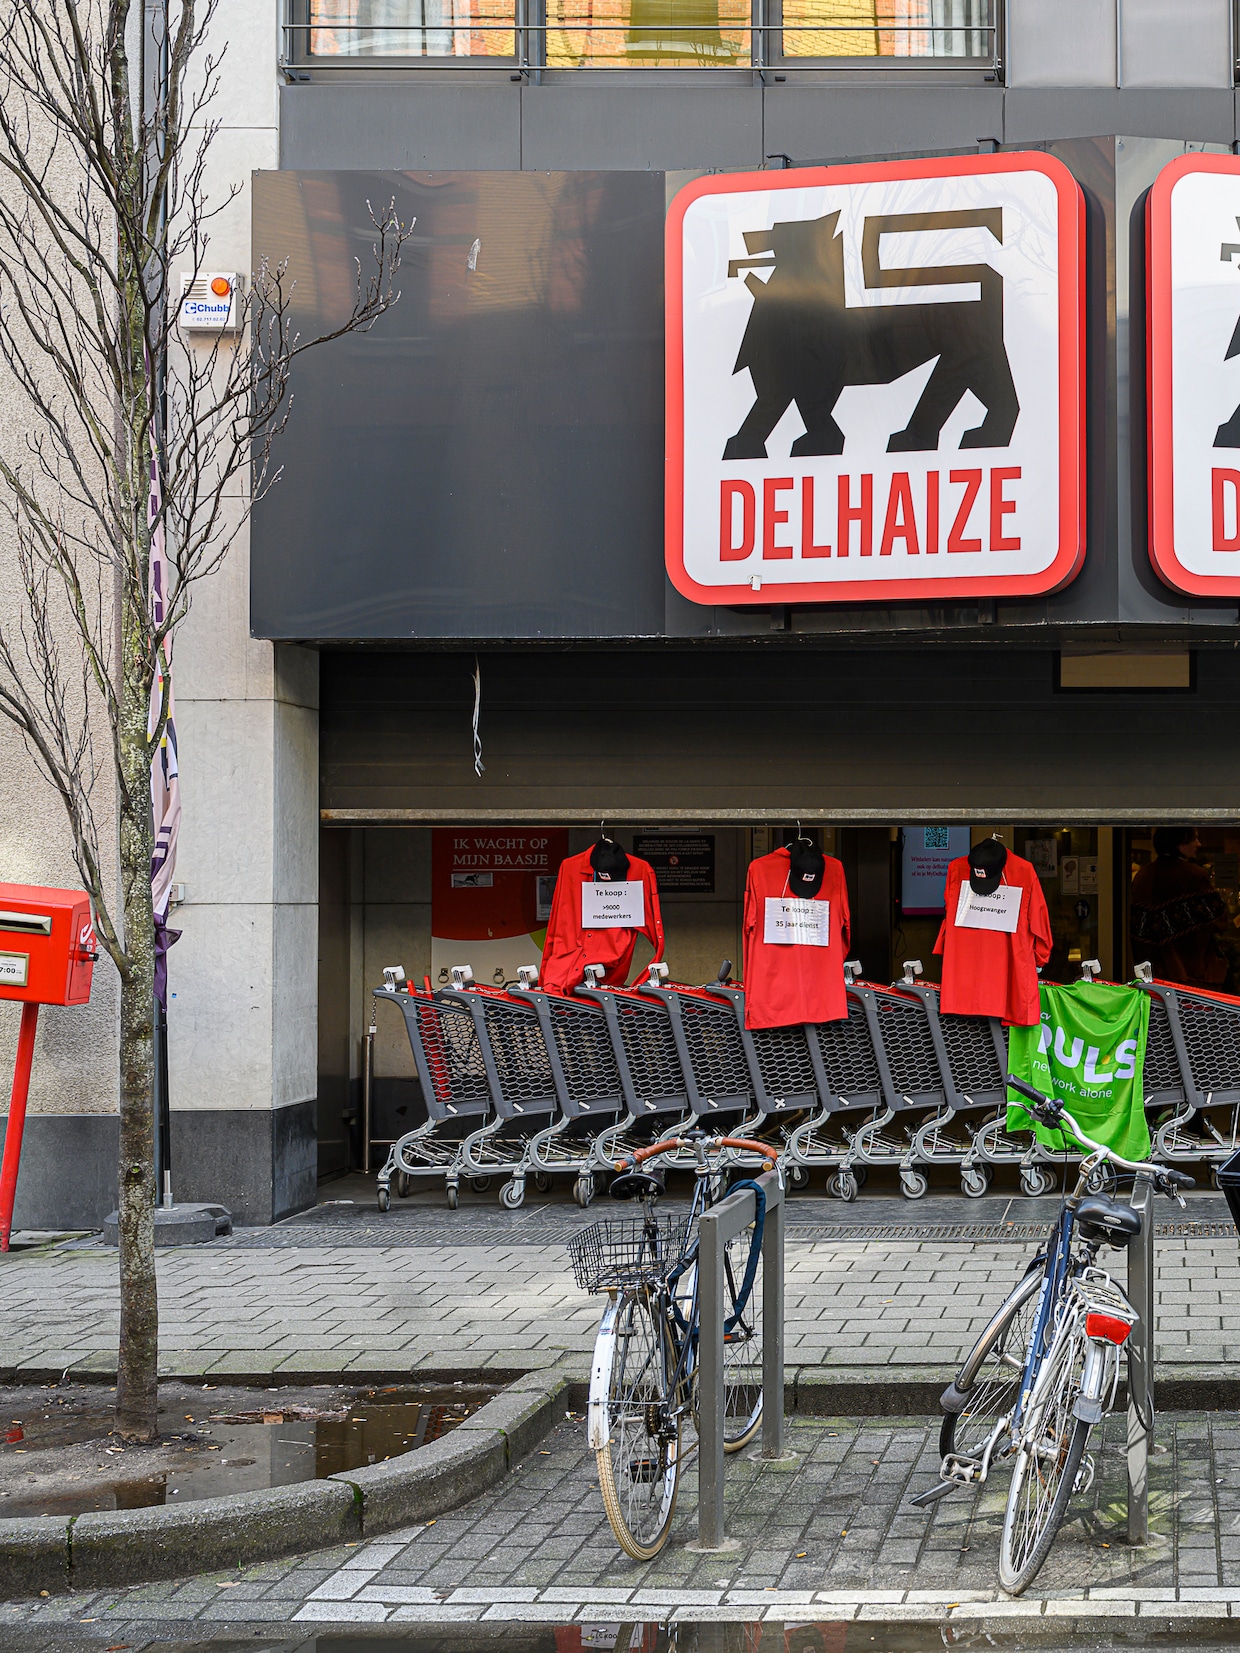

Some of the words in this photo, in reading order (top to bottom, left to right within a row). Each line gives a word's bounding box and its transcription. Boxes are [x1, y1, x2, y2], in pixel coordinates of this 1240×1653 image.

[197, 304, 231, 312] Chubb
[719, 466, 1022, 562] DELHAIZE
[454, 838, 470, 849] IK
[474, 838, 526, 849] WACHT
[529, 838, 548, 849] OP
[453, 854, 490, 865] MIJN
[494, 854, 548, 865] BAASJE
[792, 906, 809, 914] koop
[799, 921, 819, 929] dienst
[1040, 1011, 1052, 1020] cv
[1079, 1087, 1113, 1099] alone
